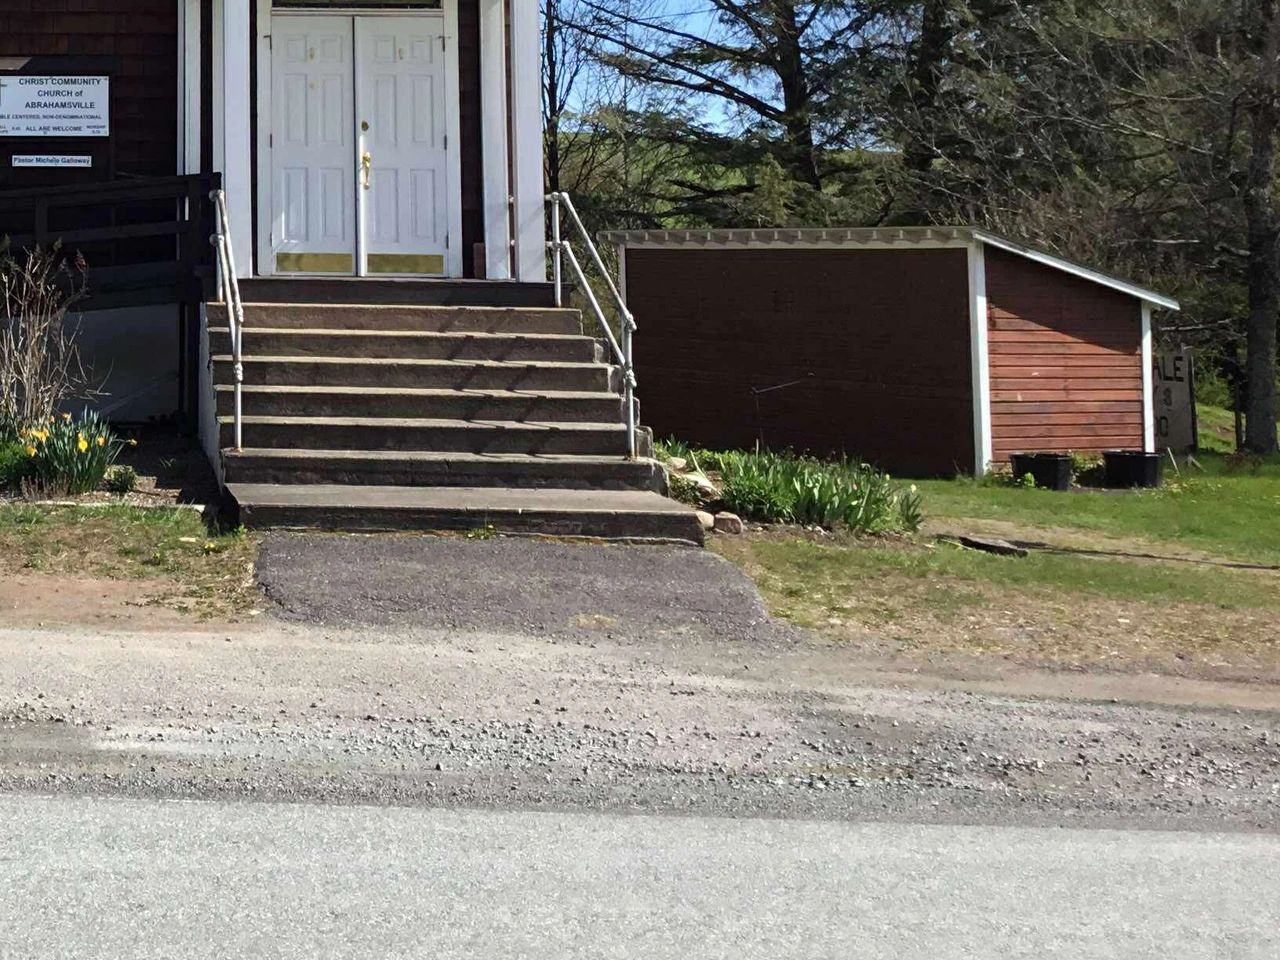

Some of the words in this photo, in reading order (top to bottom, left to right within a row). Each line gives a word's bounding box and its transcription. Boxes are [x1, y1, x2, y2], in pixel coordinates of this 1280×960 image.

[18, 78, 49, 86] CHRIST
[51, 78, 100, 86] COMMUNITY
[37, 89, 73, 97] CHURCH
[74, 89, 83, 97] of
[24, 101, 95, 109] ABRAHAMSVILLE
